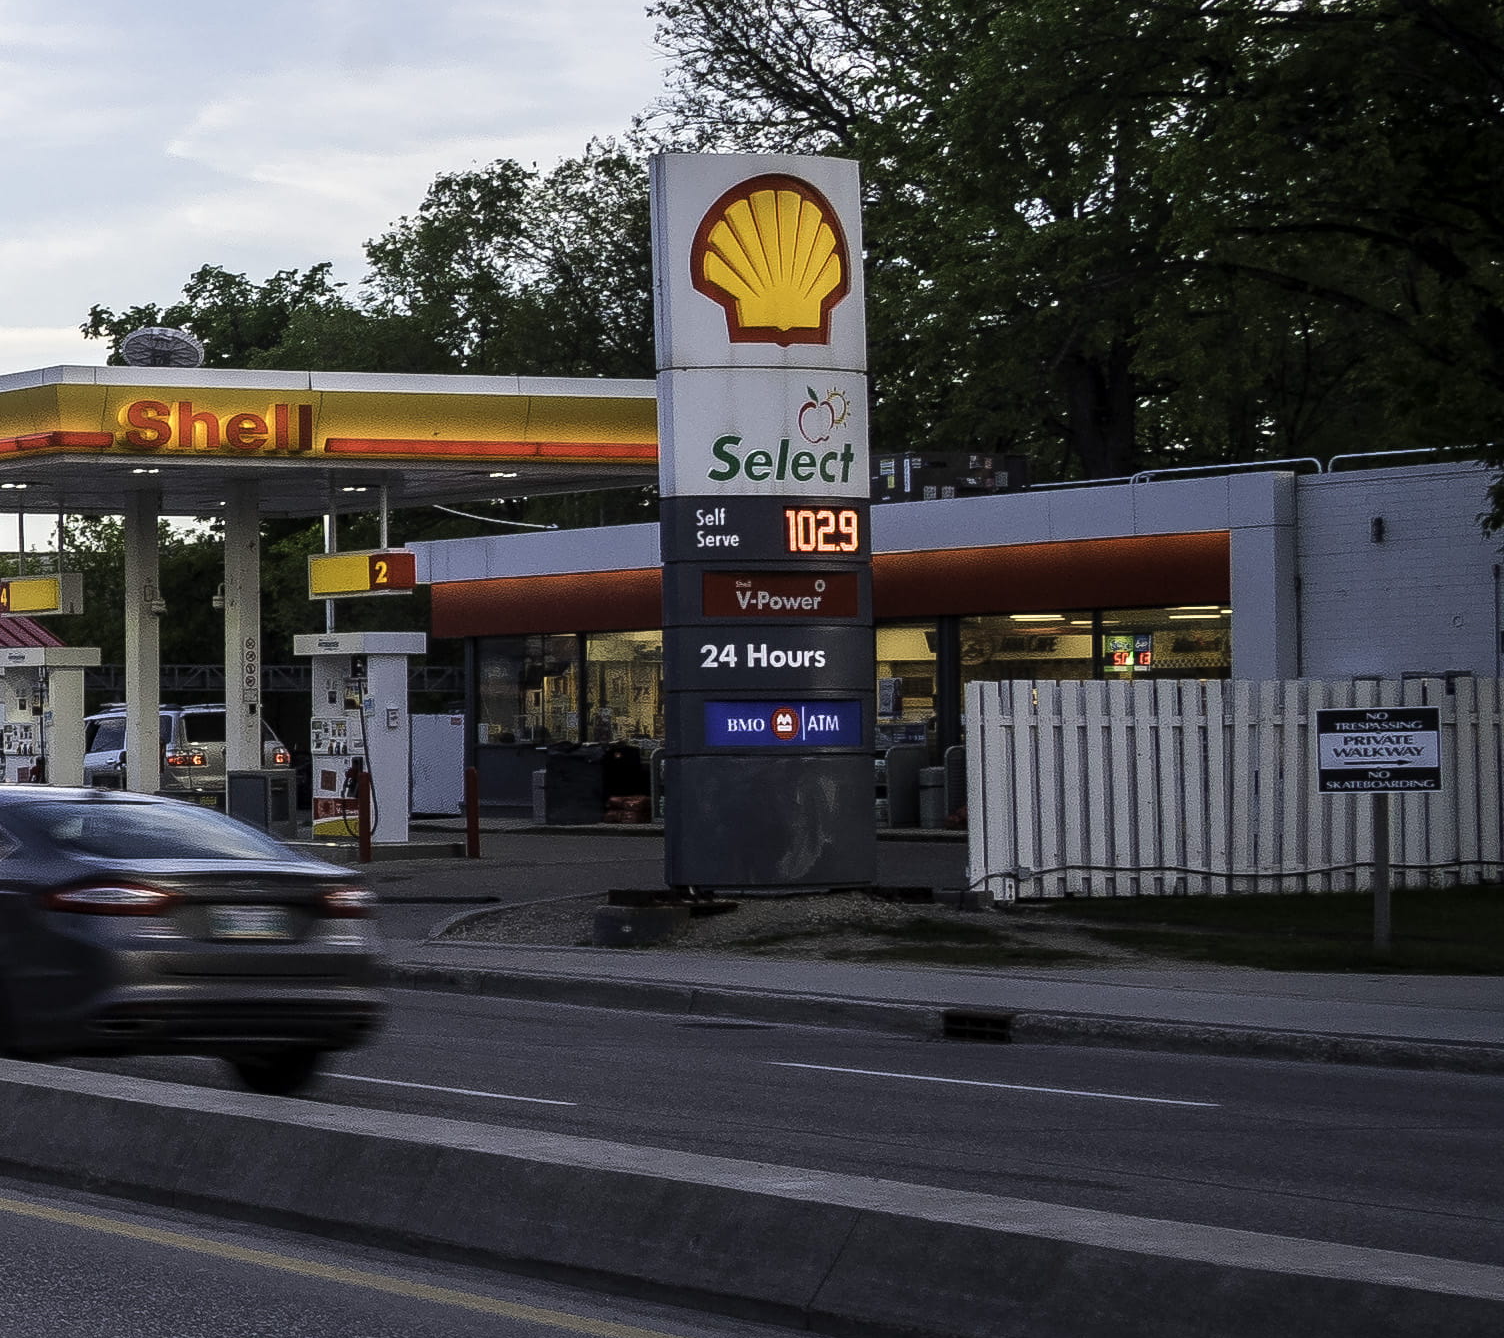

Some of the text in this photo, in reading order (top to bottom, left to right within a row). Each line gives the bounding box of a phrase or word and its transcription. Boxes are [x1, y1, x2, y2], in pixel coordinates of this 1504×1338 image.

[125, 399, 313, 451] Shell
[707, 434, 855, 483] Select
[696, 507, 726, 526] Self
[696, 530, 740, 548] Serve
[374, 561, 388, 584] 2
[0, 587, 8, 607] 4
[735, 591, 822, 610] V-Power
[700, 643, 826, 668] 24 Hours
[727, 714, 840, 732] BMO ATM
[1366, 712, 1388, 720] NO
[1335, 721, 1423, 731] TRESPASSING
[1343, 734, 1414, 746] PRIVATE
[1332, 746, 1425, 758] WALKWAY
[1368, 770, 1391, 779] NO
[1326, 779, 1435, 789] SKATEBOARDING
